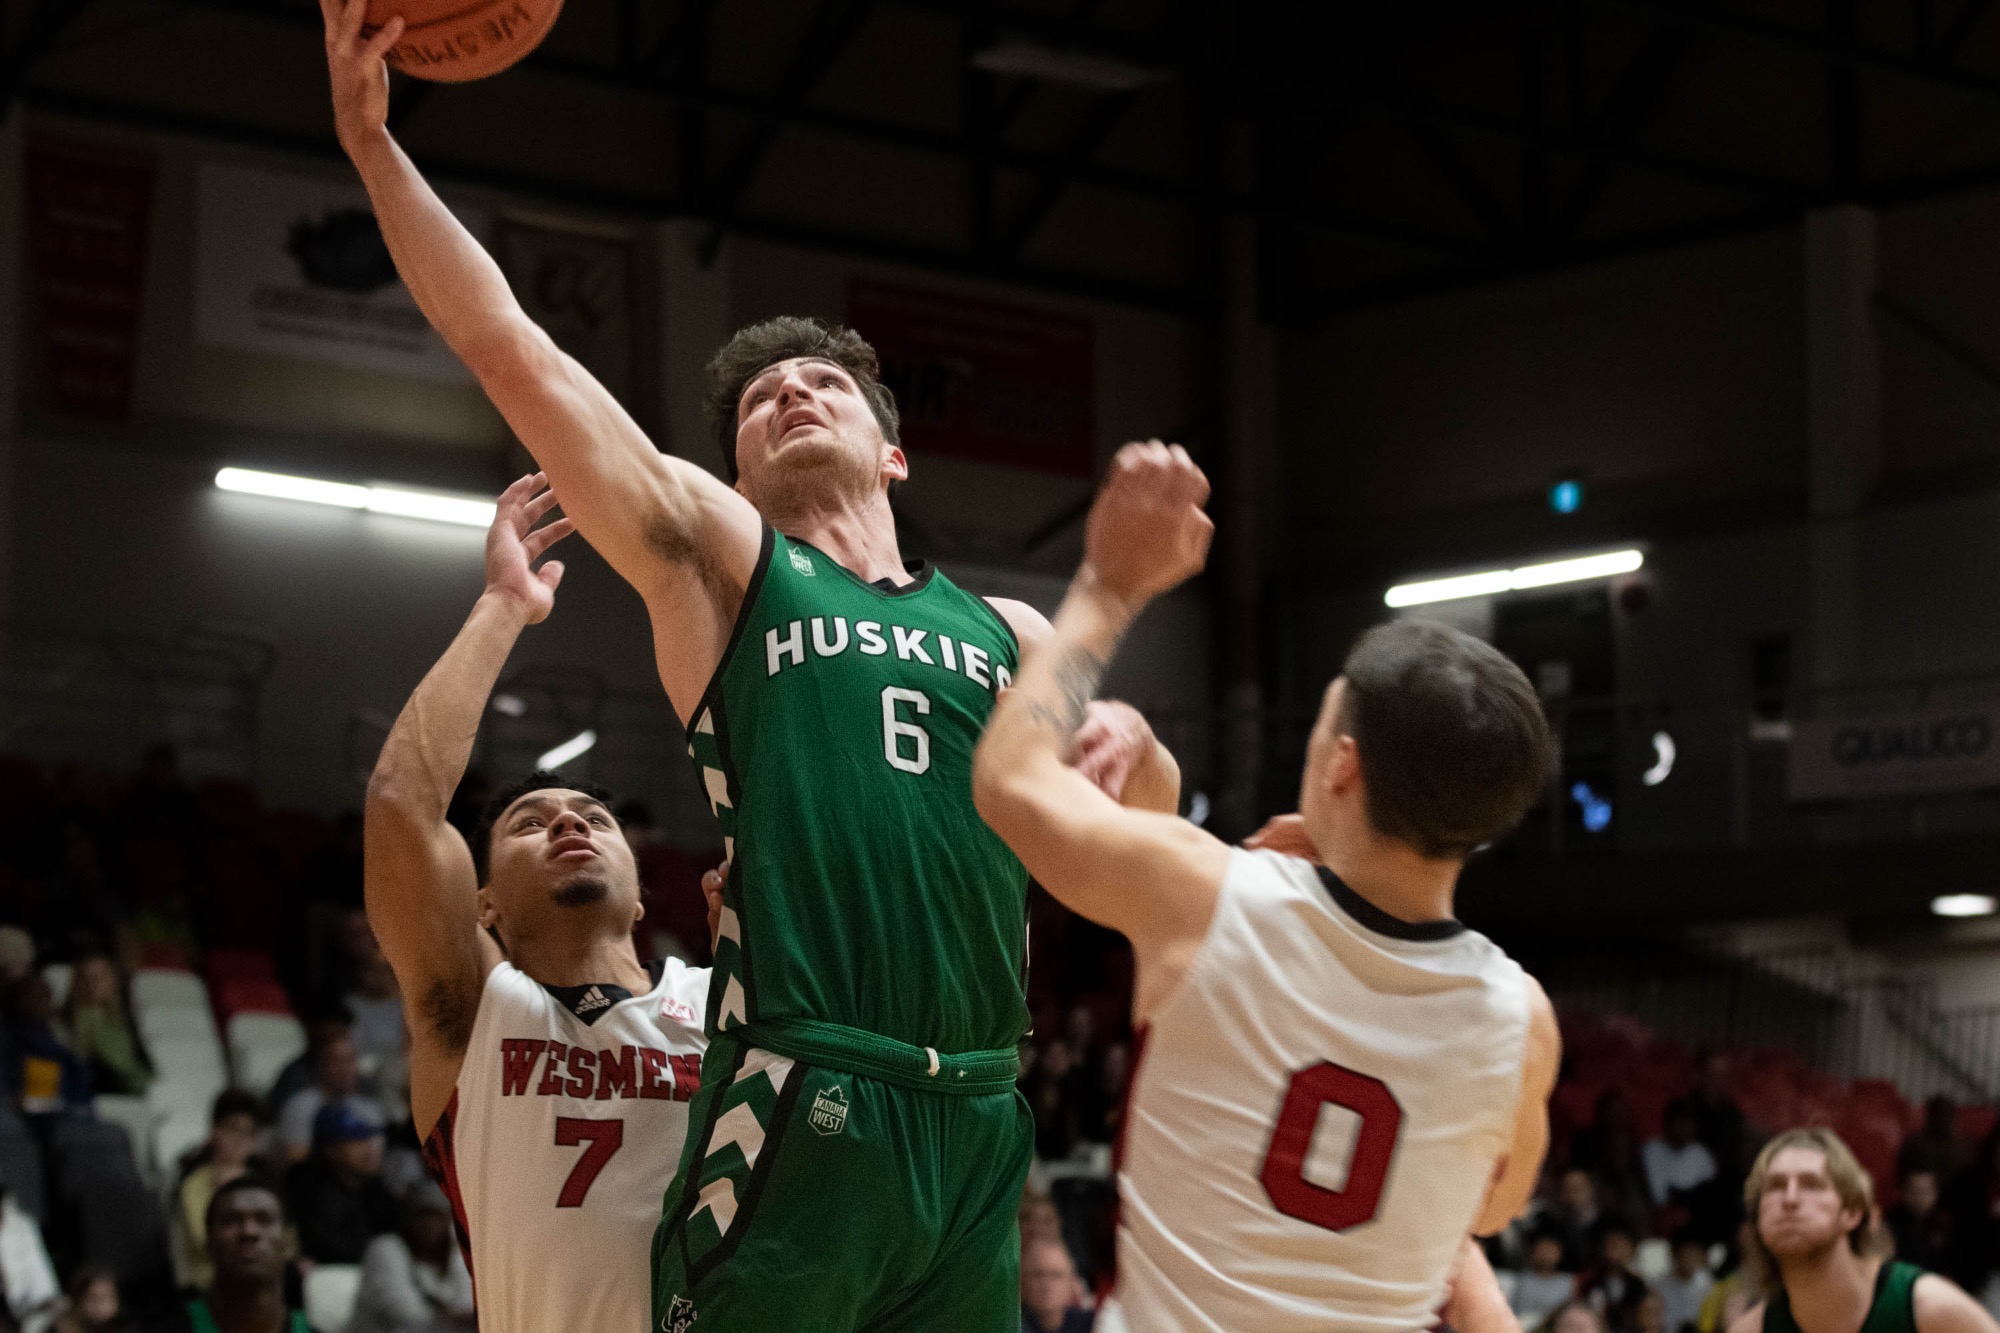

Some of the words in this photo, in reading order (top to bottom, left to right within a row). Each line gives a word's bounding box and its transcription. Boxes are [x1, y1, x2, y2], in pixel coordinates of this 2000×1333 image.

[881, 685, 931, 776] 6
[501, 1038, 701, 1102] WESMEN
[816, 1098, 845, 1118] CANADA
[812, 1109, 842, 1130] WEST
[1258, 1059, 1408, 1234] 0
[554, 1116, 624, 1208] 7
